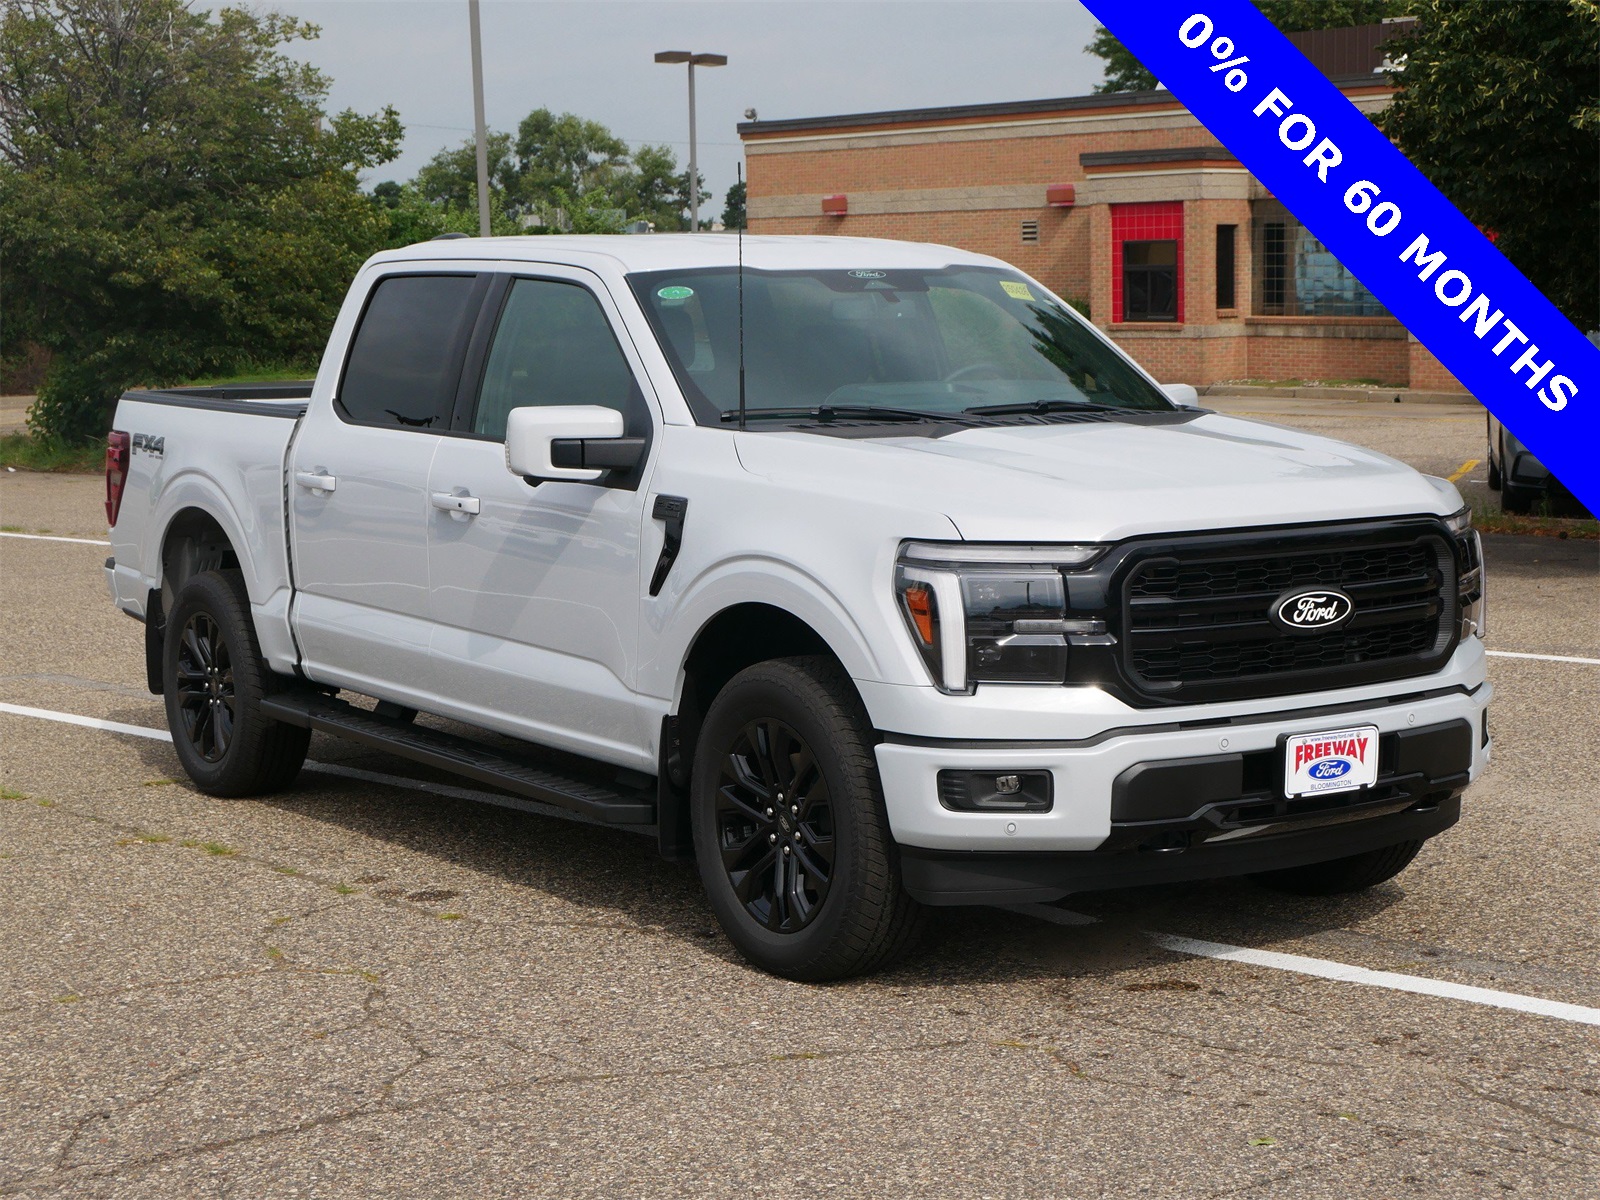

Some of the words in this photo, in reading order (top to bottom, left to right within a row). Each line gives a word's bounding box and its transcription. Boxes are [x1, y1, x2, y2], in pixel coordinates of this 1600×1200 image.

[132, 433, 165, 455] FX4
[1293, 596, 1338, 623] Ford
[1294, 737, 1369, 775] FREEWAY
[1315, 761, 1345, 777] Ford
[1310, 779, 1352, 790] BLOOMINGTON
